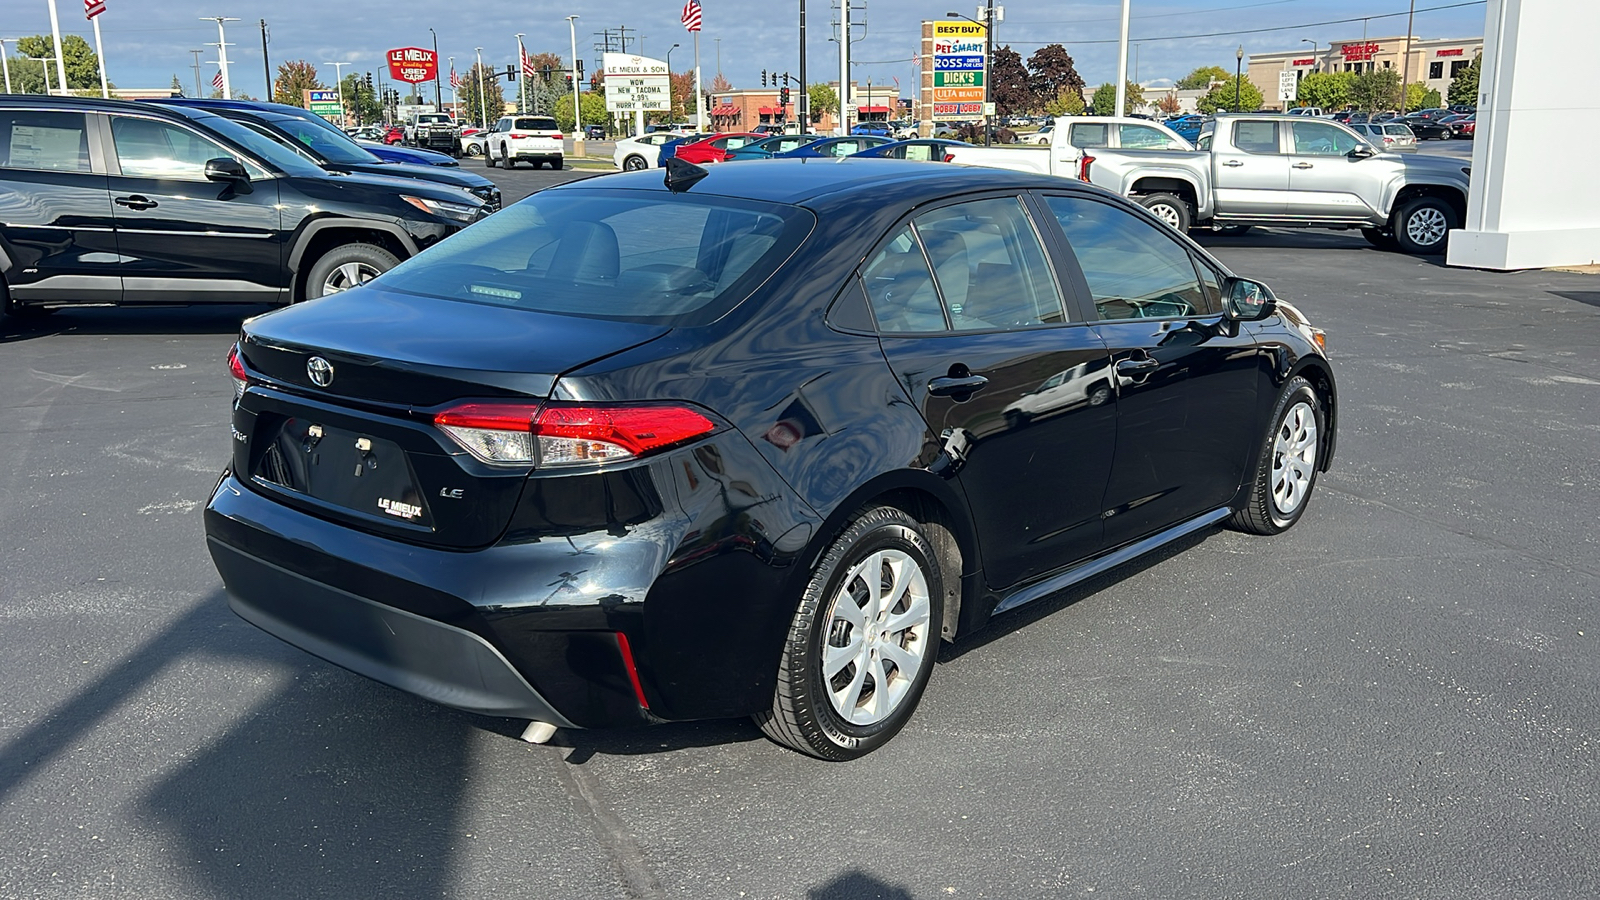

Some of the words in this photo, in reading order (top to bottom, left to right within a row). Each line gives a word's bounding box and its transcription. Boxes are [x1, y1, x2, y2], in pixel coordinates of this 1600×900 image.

[935, 43, 983, 53] PETSMART
[391, 51, 402, 60] LE
[404, 50, 432, 61] MIEUX
[935, 58, 963, 68] ROSS
[944, 72, 974, 83] DICK'S
[321, 92, 339, 100] ALD
[937, 89, 958, 98] ULTA
[958, 90, 982, 98] BEAUTY
[934, 104, 958, 113] HOBBY
[960, 104, 982, 113] LOBBY
[440, 487, 464, 499] LE
[377, 498, 390, 509] LE
[390, 501, 422, 517] MIEUX
[912, 536, 939, 576] MICHELIN
[816, 706, 848, 744] MICHELIN
